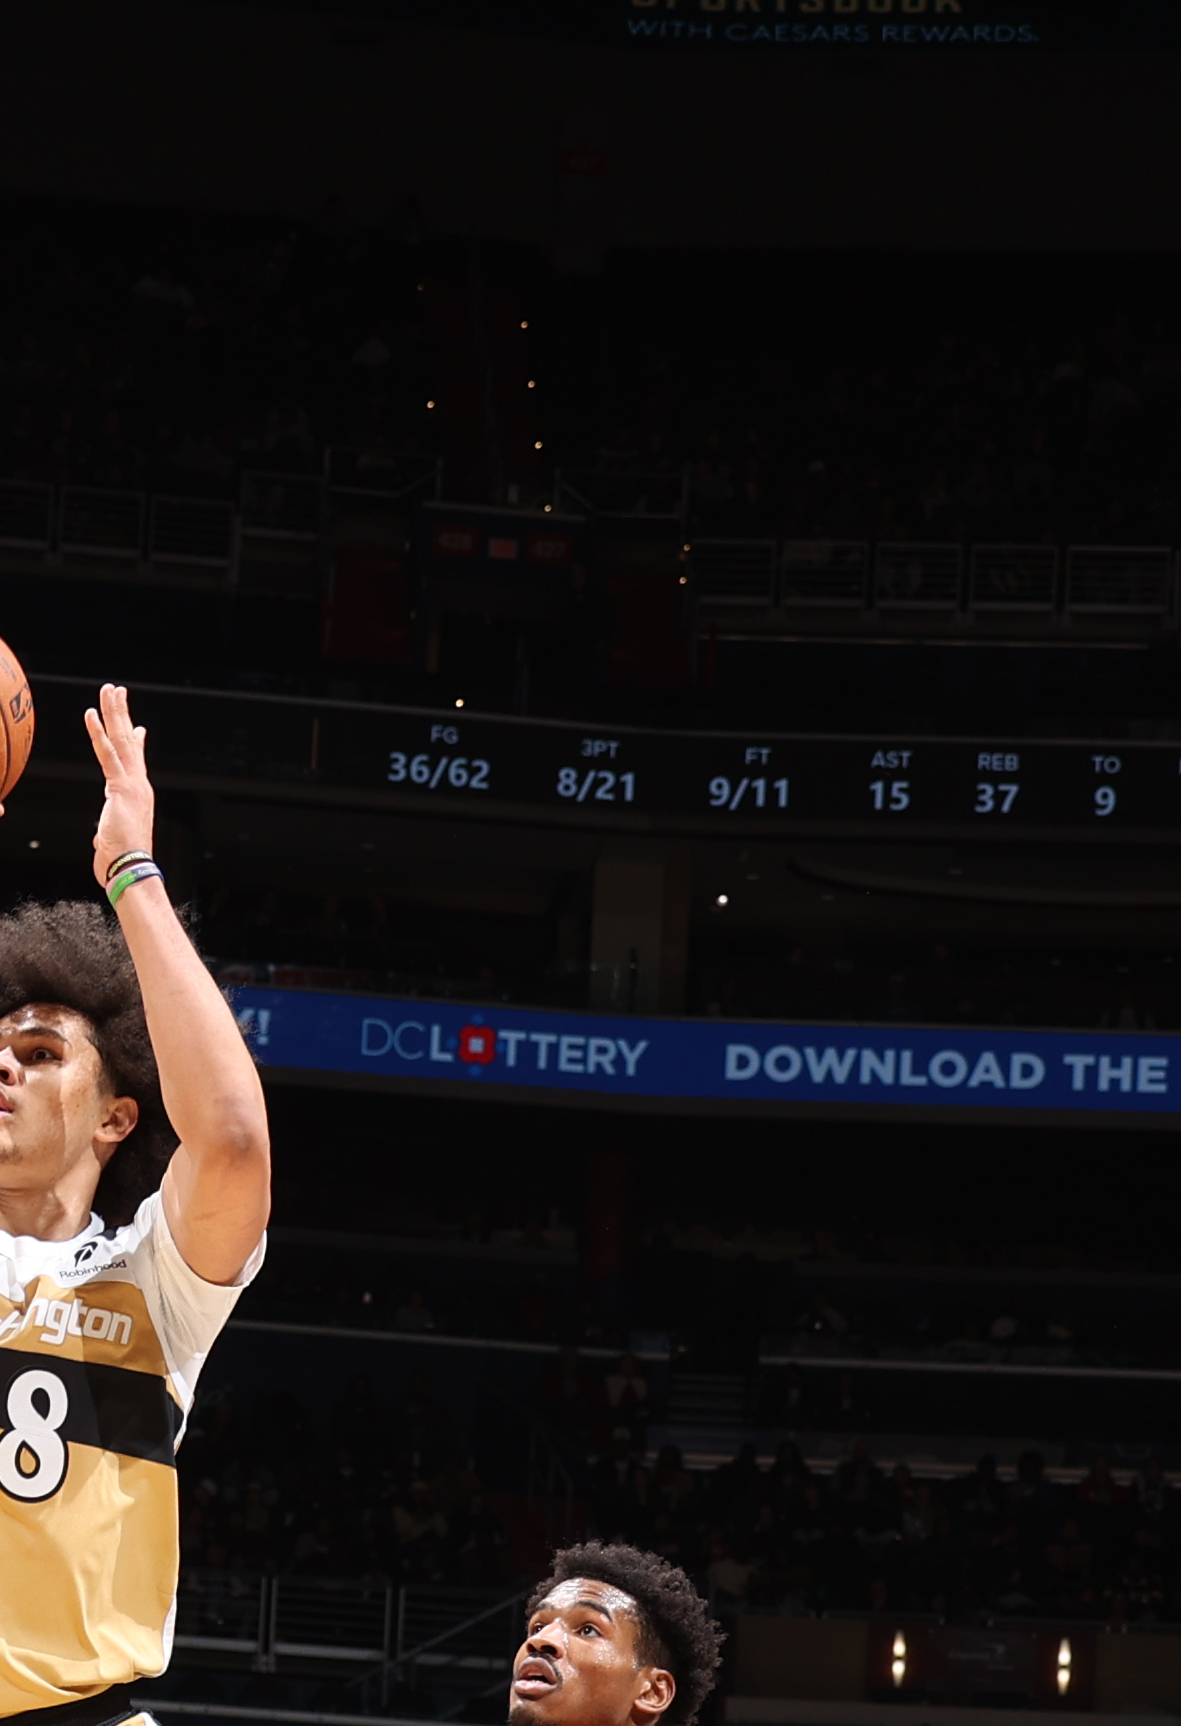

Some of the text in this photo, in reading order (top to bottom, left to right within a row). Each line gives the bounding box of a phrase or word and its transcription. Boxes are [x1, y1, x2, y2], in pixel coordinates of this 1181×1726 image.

[626, 18, 713, 41] WITH
[724, 22, 870, 43] CAESARS
[429, 724, 1122, 775] FG 3PT FT AST REB TO
[387, 751, 1118, 817] 36/62 8/21 9/11 15 37 9
[724, 1043, 1047, 1090] DOWNLOAD
[1062, 1053, 1169, 1094] THE
[59, 1258, 128, 1280] Robinhood
